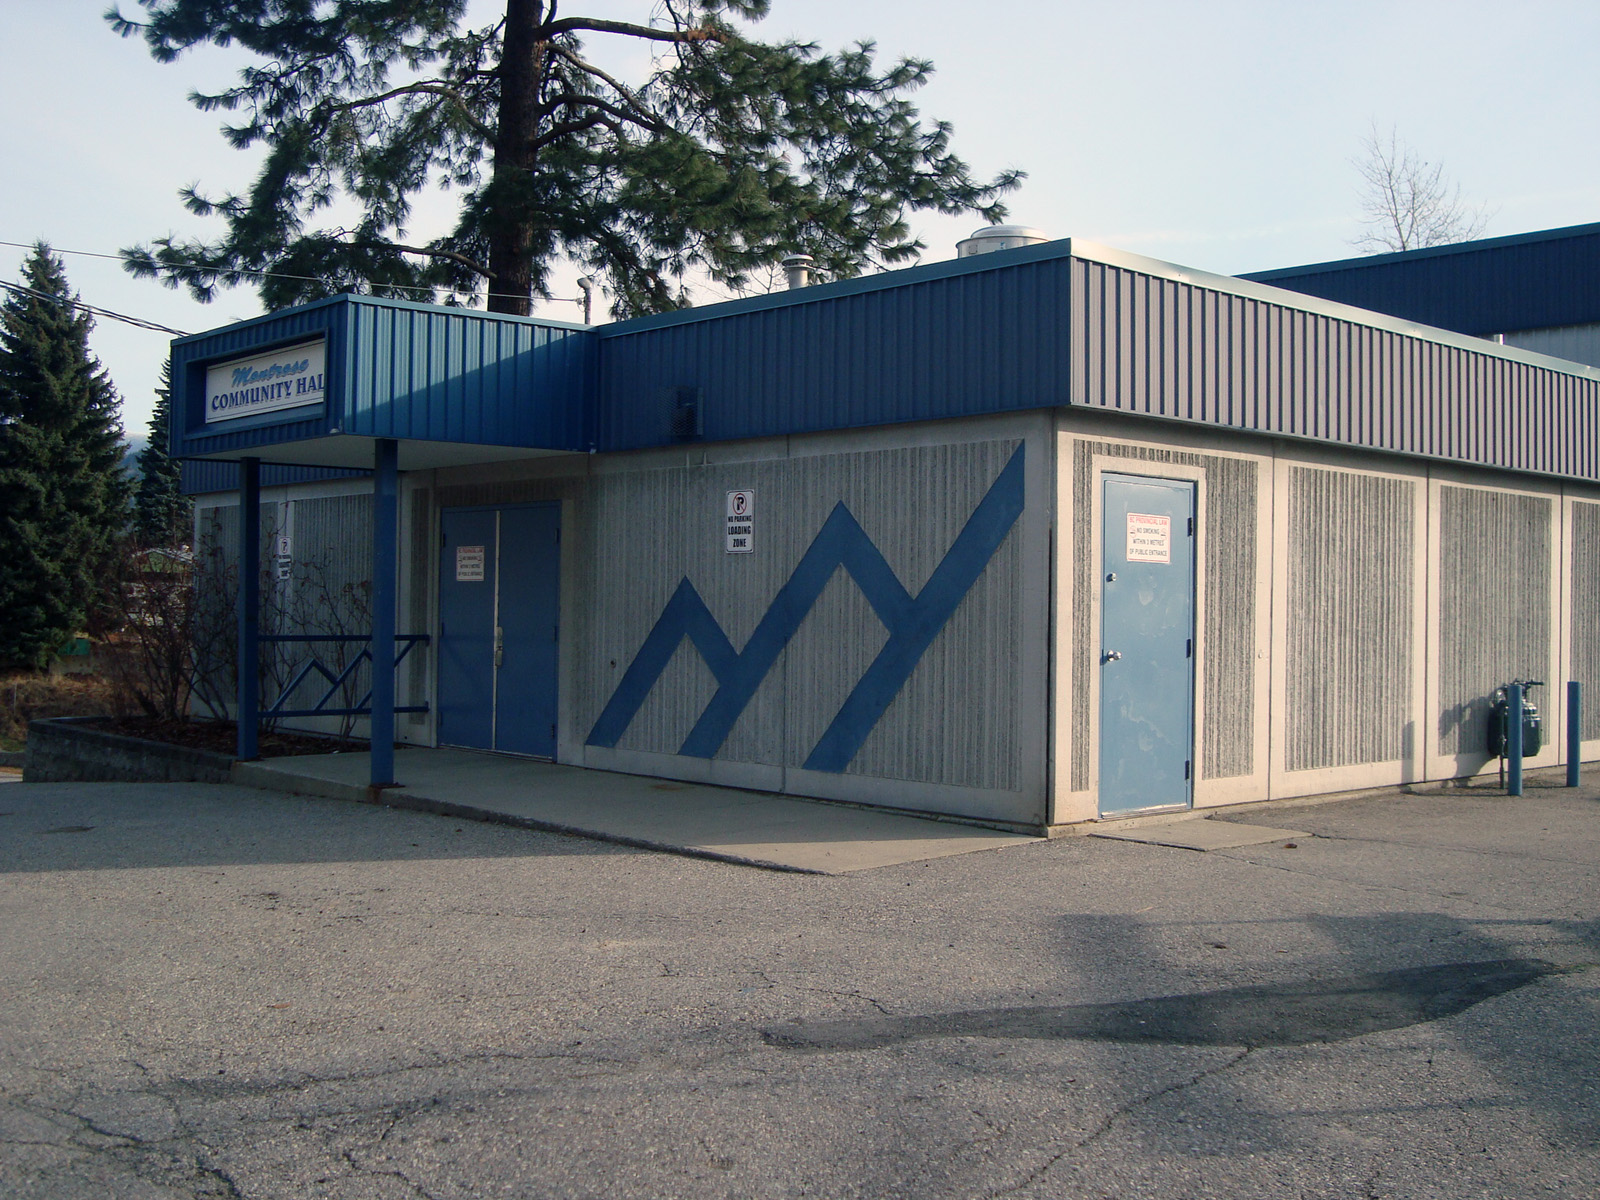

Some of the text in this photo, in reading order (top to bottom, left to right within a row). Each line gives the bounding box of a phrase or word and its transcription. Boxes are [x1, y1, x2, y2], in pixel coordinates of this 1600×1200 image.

[212, 374, 325, 411] COMMUNITY HAL
[728, 526, 751, 535] LOADING
[733, 539, 746, 547] ZONE
